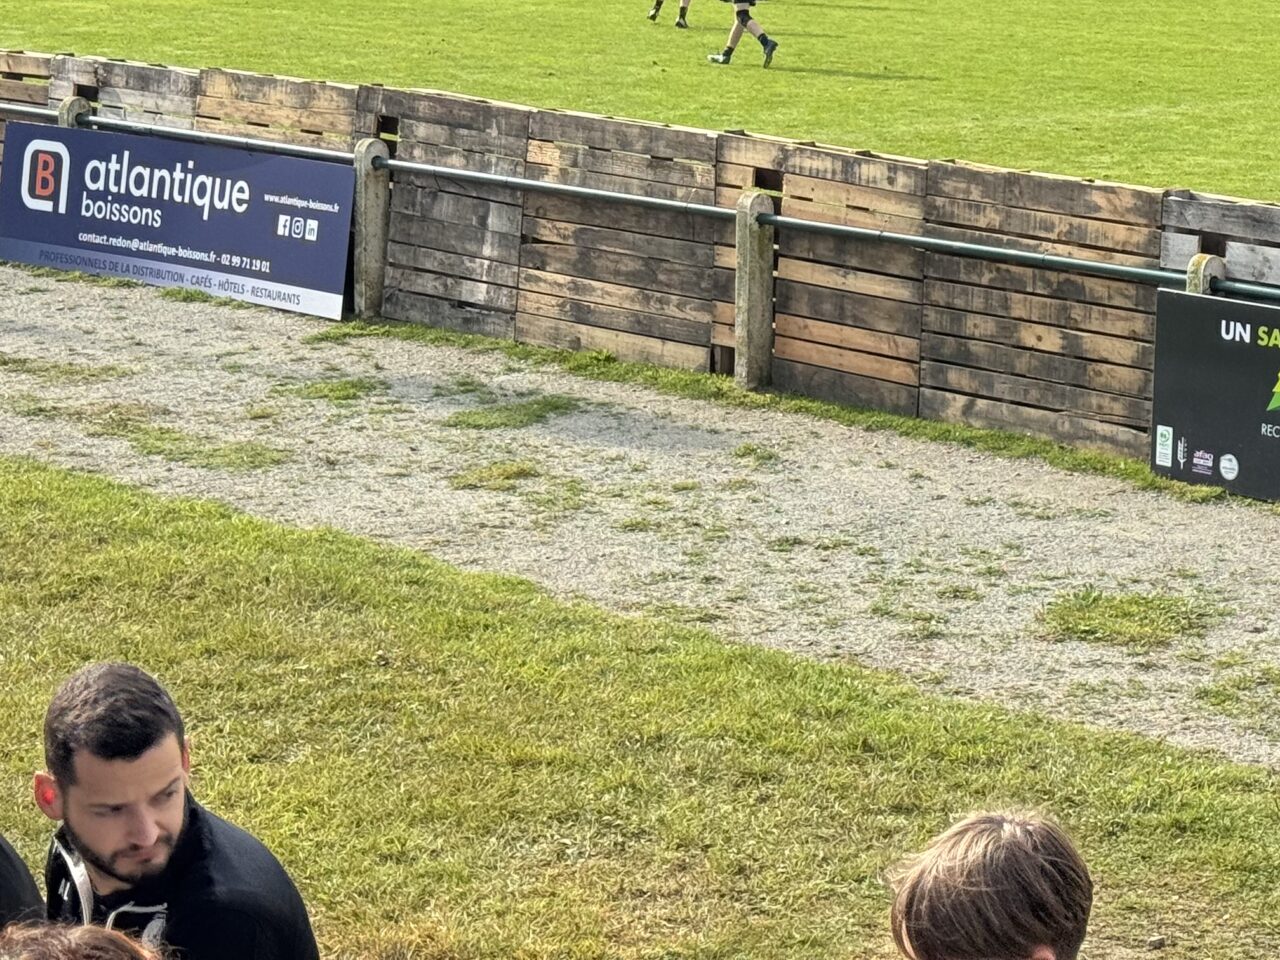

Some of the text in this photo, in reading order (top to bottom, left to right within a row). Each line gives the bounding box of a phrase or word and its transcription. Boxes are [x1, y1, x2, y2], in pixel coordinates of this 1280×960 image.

[84, 150, 250, 221] atlantique
[264, 193, 340, 213] www.atlantique-boissons.fr
[81, 191, 163, 228] boissons
[78, 232, 216, 262] contact.redon@atlantique-boissons.fr
[221, 253, 230, 266] 02
[231, 255, 241, 267] 99
[241, 256, 250, 269] 71
[251, 258, 261, 271] 19
[261, 260, 270, 273] 01
[39, 250, 107, 271] PROFESSIONNELS
[108, 261, 119, 272] DE
[120, 262, 130, 274] LA
[132, 264, 185, 284] DISTRIBUTION
[190, 273, 213, 288] CAFÉS
[218, 278, 245, 295] HÔTELS
[251, 285, 301, 306] RESTAURANTS
[1220, 319, 1251, 344] UN
